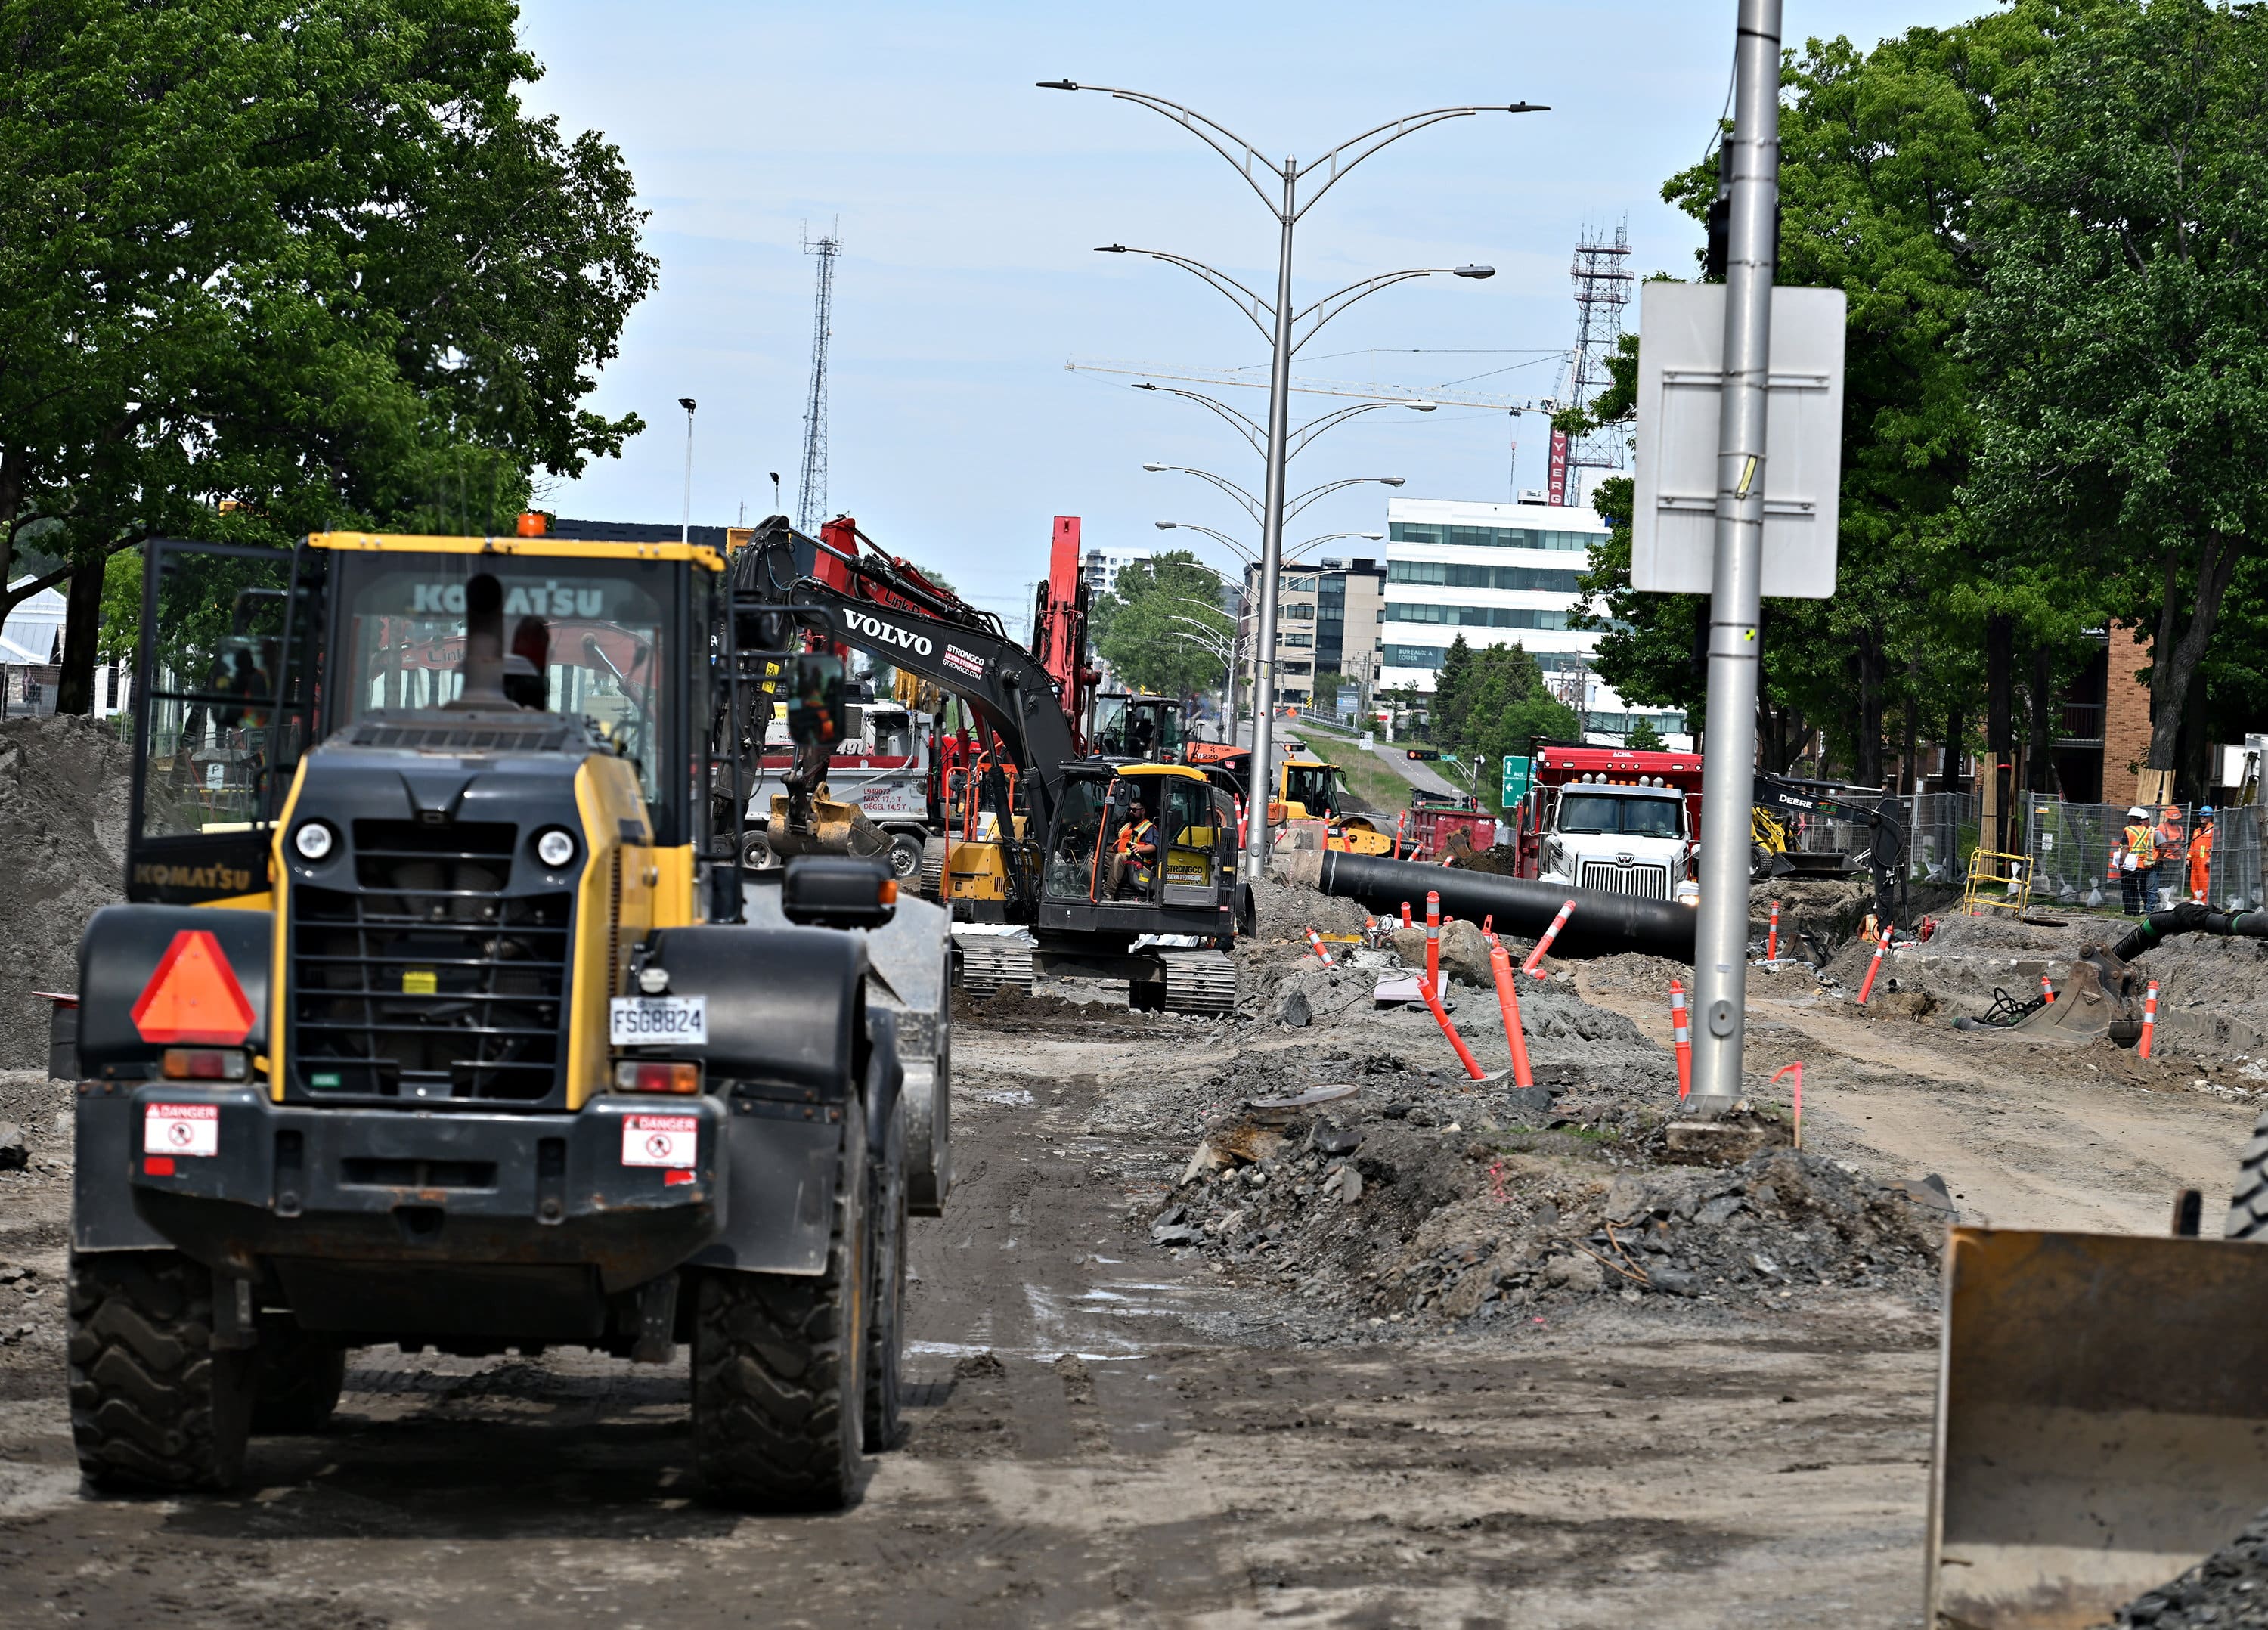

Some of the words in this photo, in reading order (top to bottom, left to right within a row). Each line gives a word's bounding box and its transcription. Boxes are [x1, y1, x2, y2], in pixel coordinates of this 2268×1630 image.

[414, 581, 603, 617] KOATSU
[843, 608, 933, 656] VOLVO
[947, 643, 984, 667] STRONGCO
[943, 659, 982, 680] STRONGCO.COM
[1778, 793, 1814, 809] DEERE
[133, 863, 251, 891] KOMATSU
[160, 1105, 217, 1118] DANGER
[639, 1117, 696, 1130] DANGER
